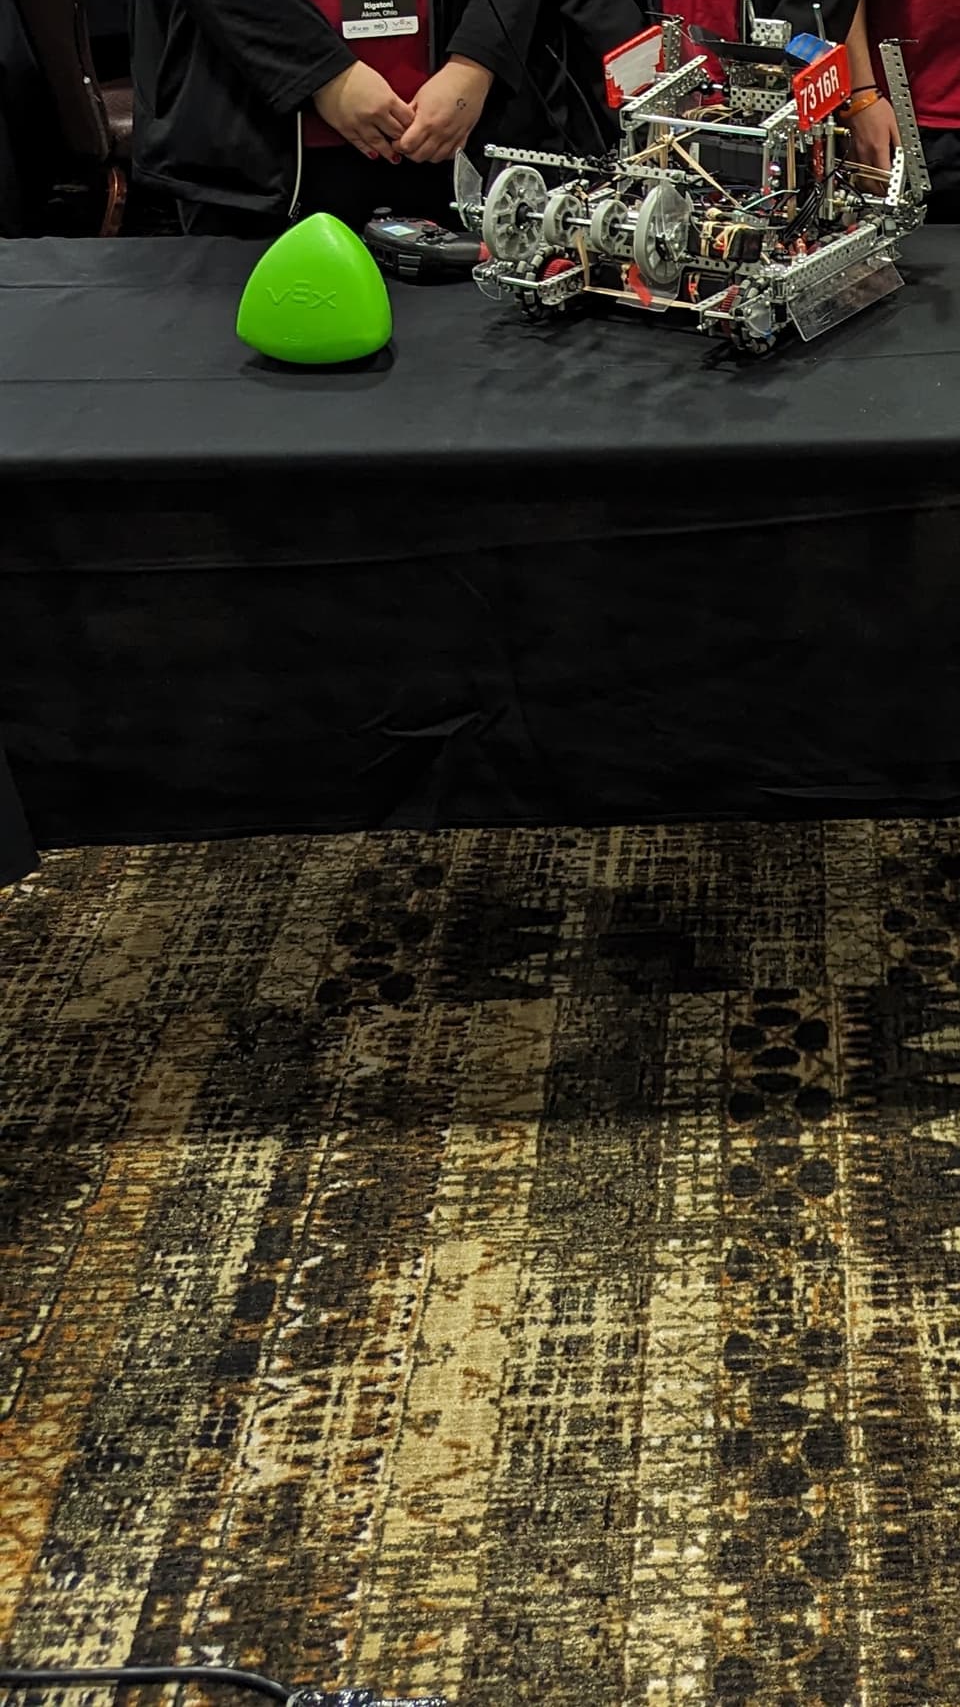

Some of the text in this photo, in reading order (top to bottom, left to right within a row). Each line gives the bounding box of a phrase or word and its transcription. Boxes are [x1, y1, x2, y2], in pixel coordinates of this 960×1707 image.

[364, 1, 393, 10] Rigatoni
[800, 65, 839, 116] 7316R
[265, 279, 337, 309] VEX
